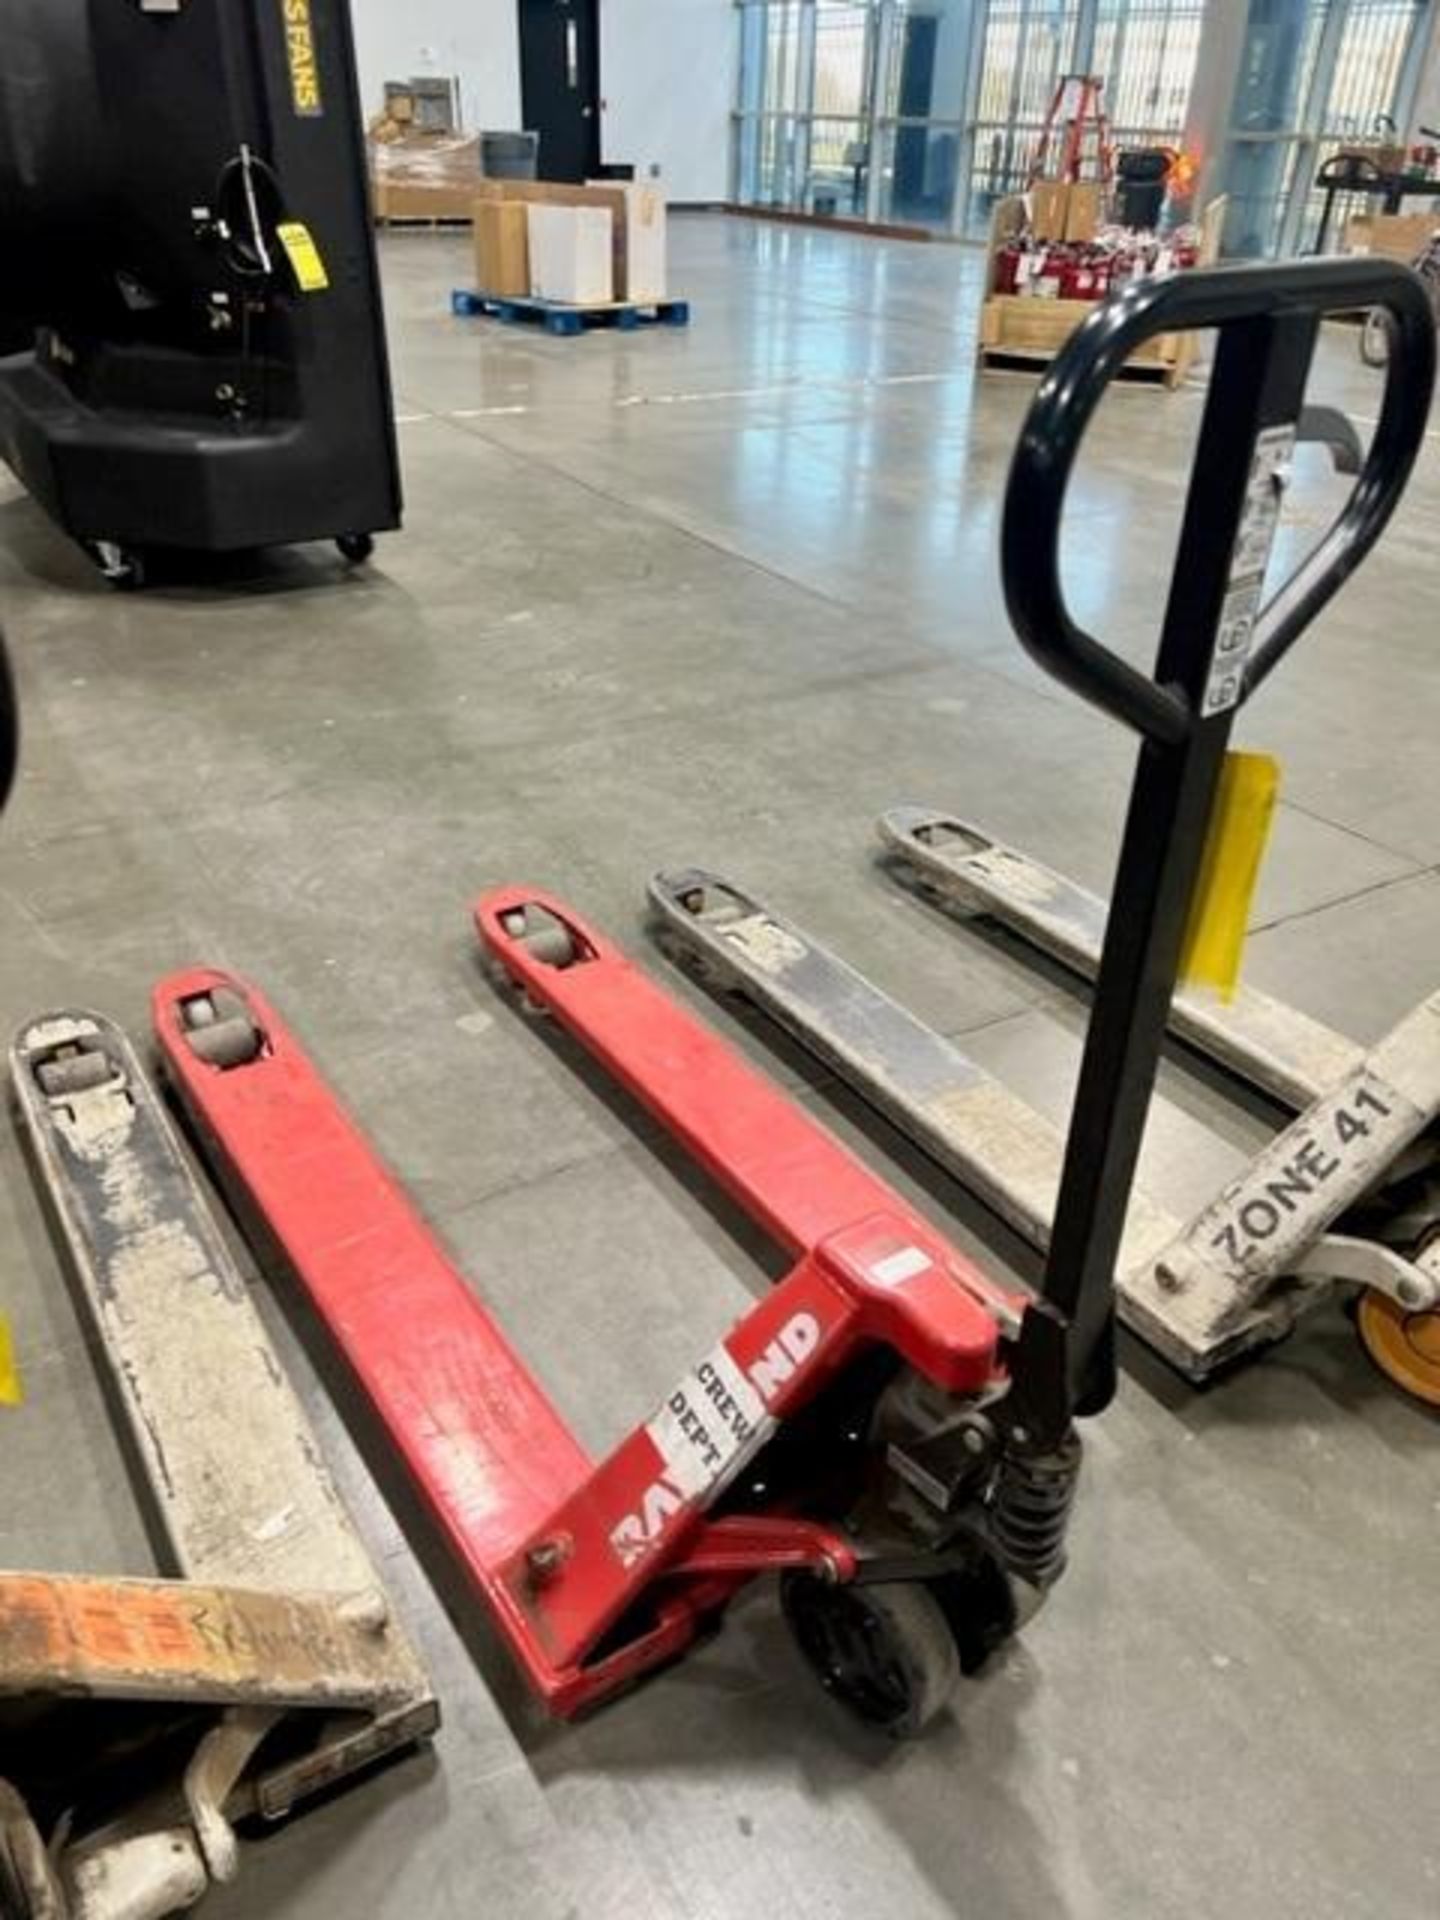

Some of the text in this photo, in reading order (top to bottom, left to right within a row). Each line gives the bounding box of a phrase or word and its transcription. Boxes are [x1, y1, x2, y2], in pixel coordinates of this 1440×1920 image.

[1211, 1088, 1391, 1264] ZONE 41
[696, 1362, 758, 1443] CREW
